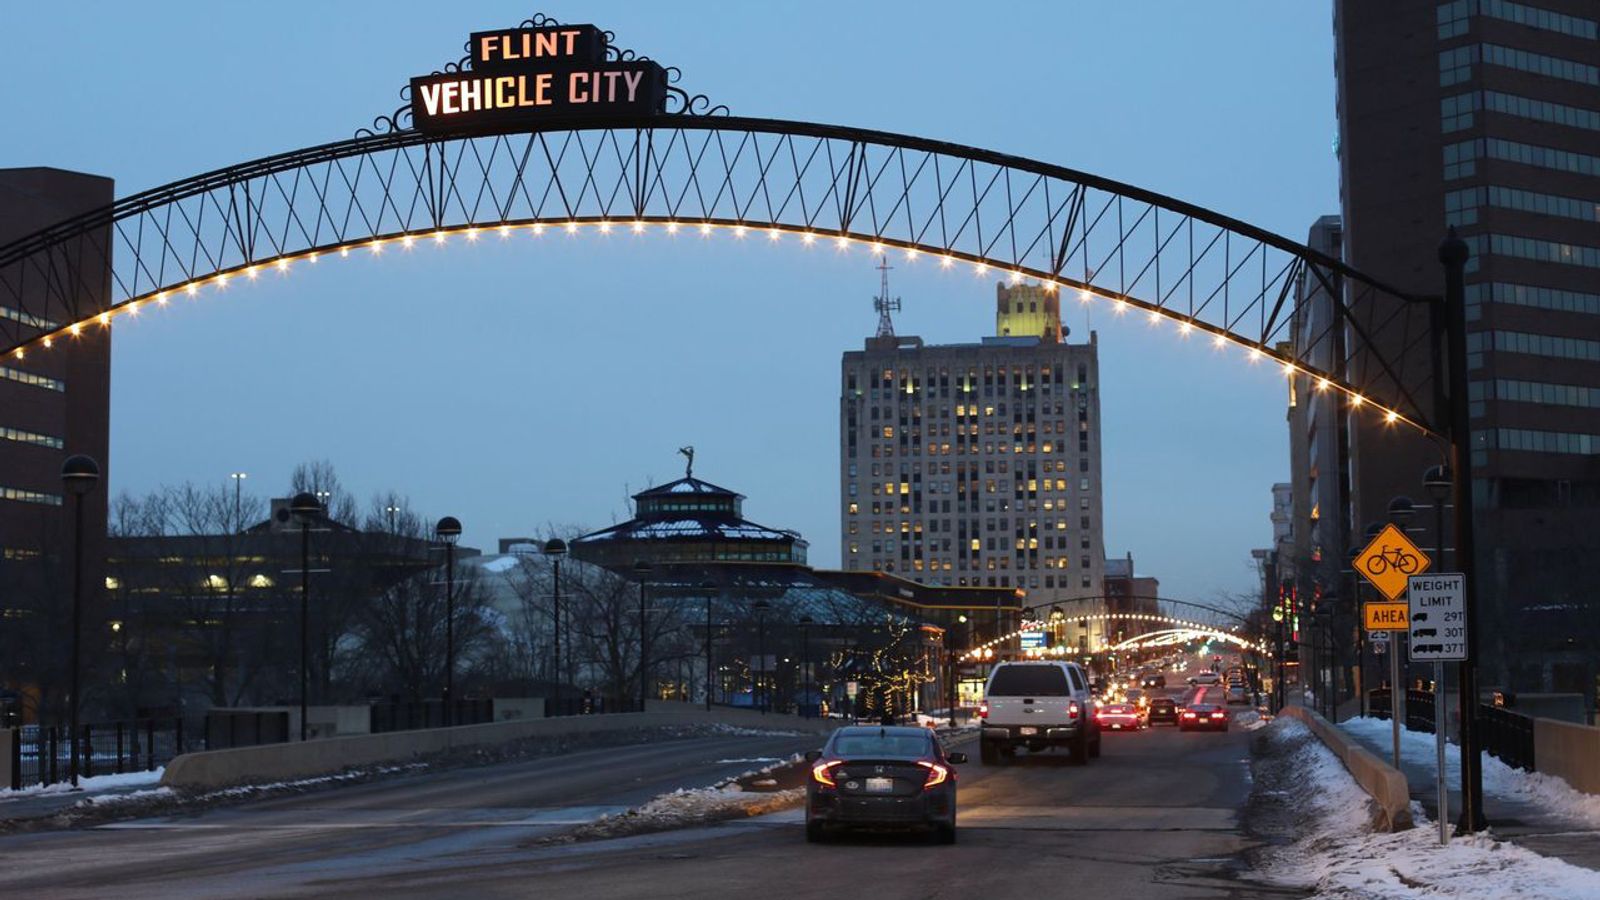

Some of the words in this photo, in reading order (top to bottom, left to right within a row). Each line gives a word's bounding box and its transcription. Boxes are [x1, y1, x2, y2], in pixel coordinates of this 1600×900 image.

[481, 30, 581, 62] FLINT
[420, 74, 553, 116] VEHICLE
[568, 71, 644, 103] CITY
[1412, 580, 1460, 591] WEIGHT
[1420, 596, 1453, 607] LIMIT
[1372, 610, 1408, 623] AHEA
[1443, 611, 1464, 622] 29T
[1444, 627, 1465, 638] 30T
[1444, 643, 1465, 653] 37T
